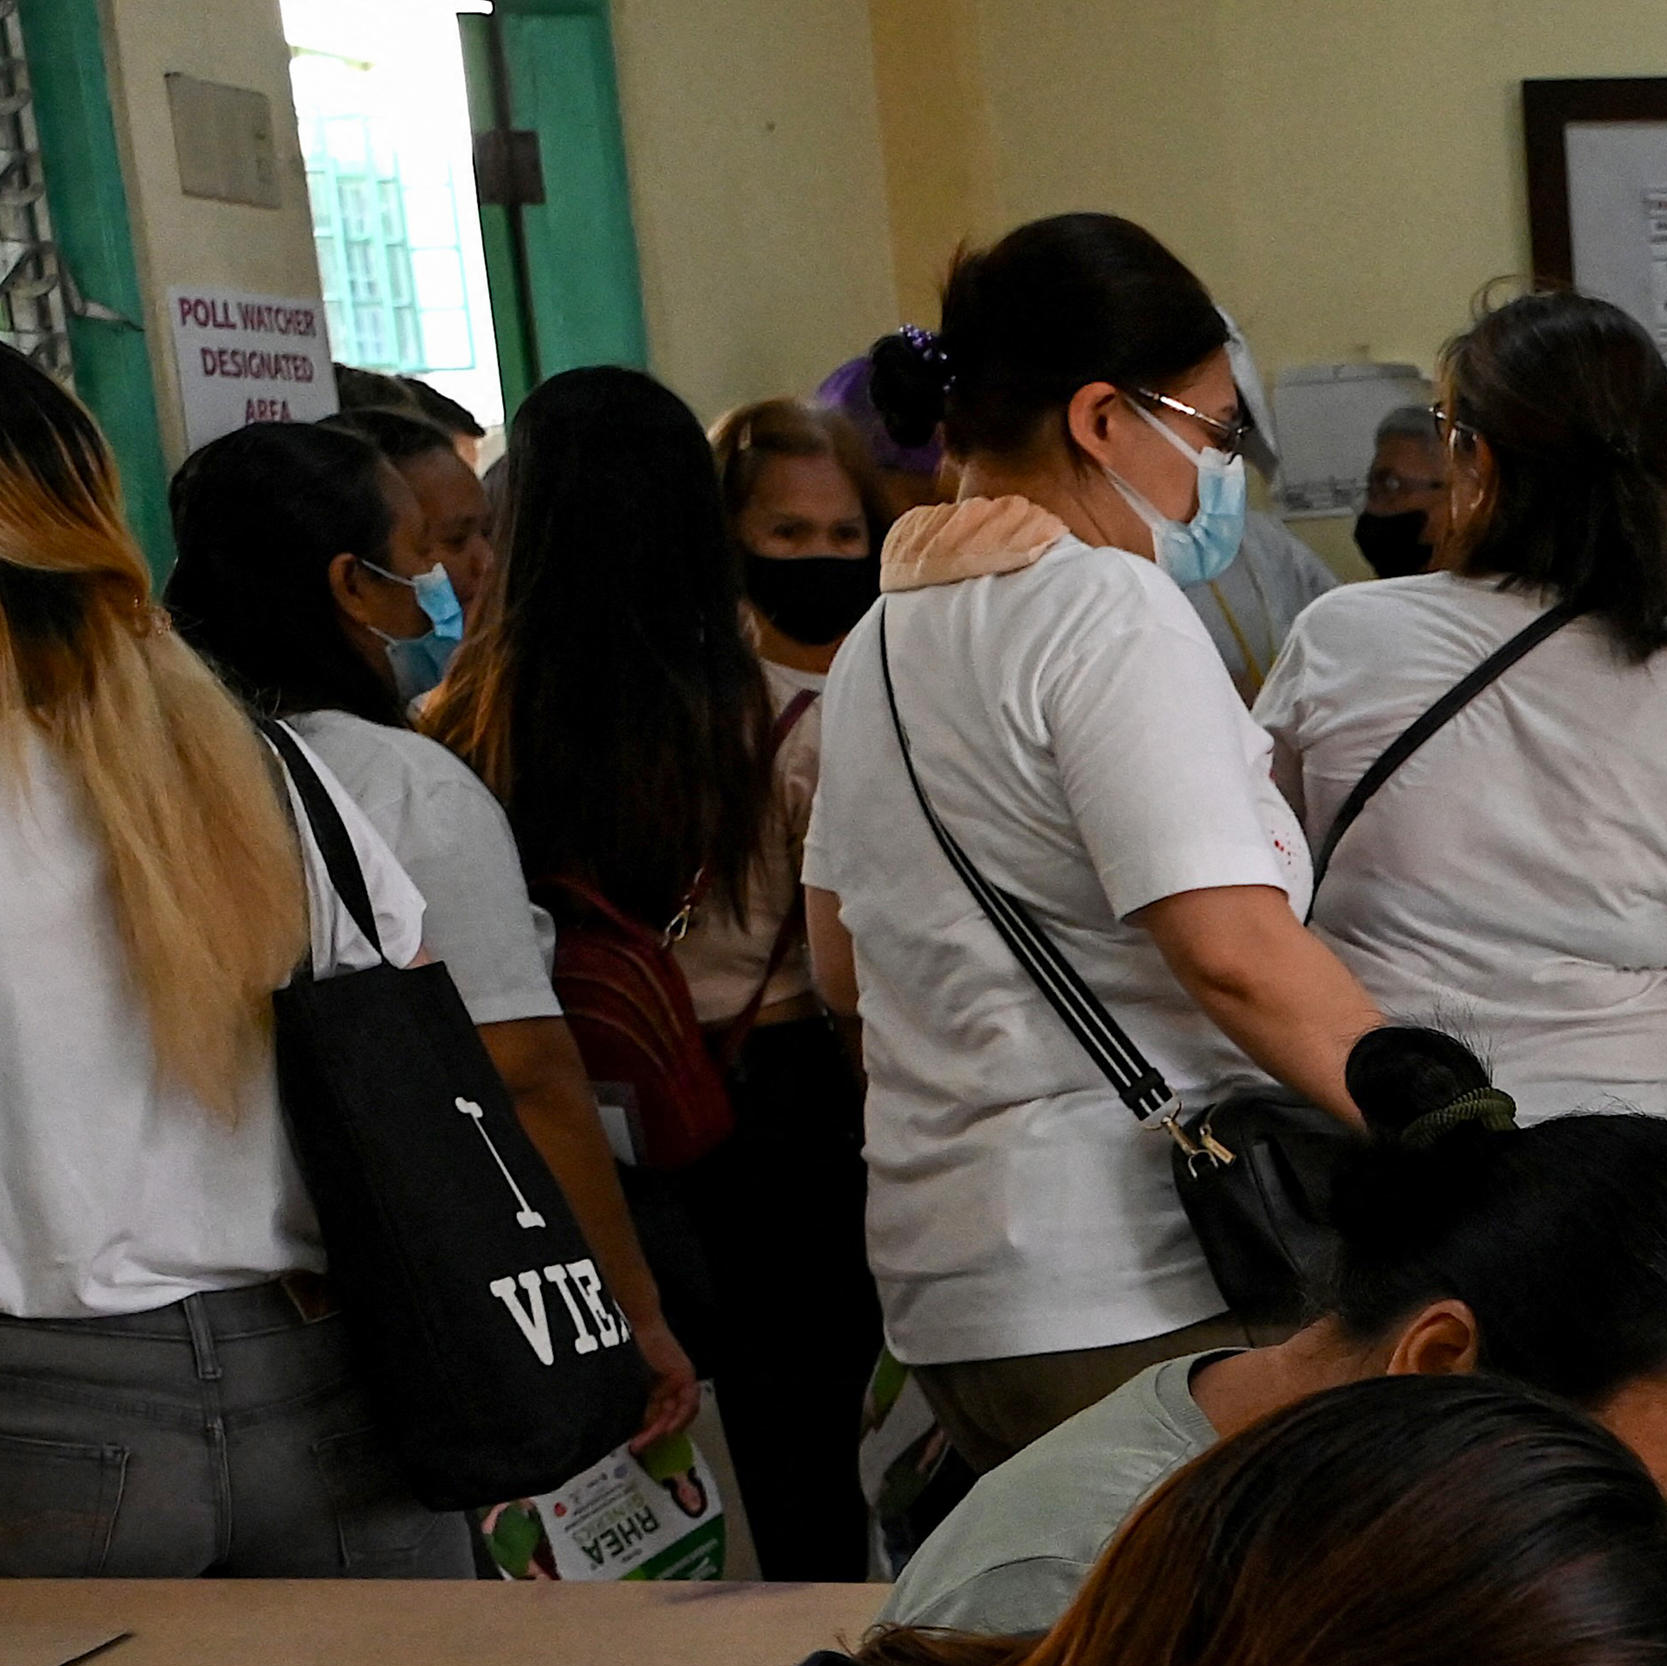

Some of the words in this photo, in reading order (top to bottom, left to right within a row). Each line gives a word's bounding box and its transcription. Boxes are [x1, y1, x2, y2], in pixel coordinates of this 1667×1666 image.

[178, 298, 237, 330] POLL
[237, 302, 317, 338] WATCHER
[201, 347, 315, 383] DESIGNATED
[245, 398, 292, 424] AREA
[581, 1505, 660, 1565] RHEA
